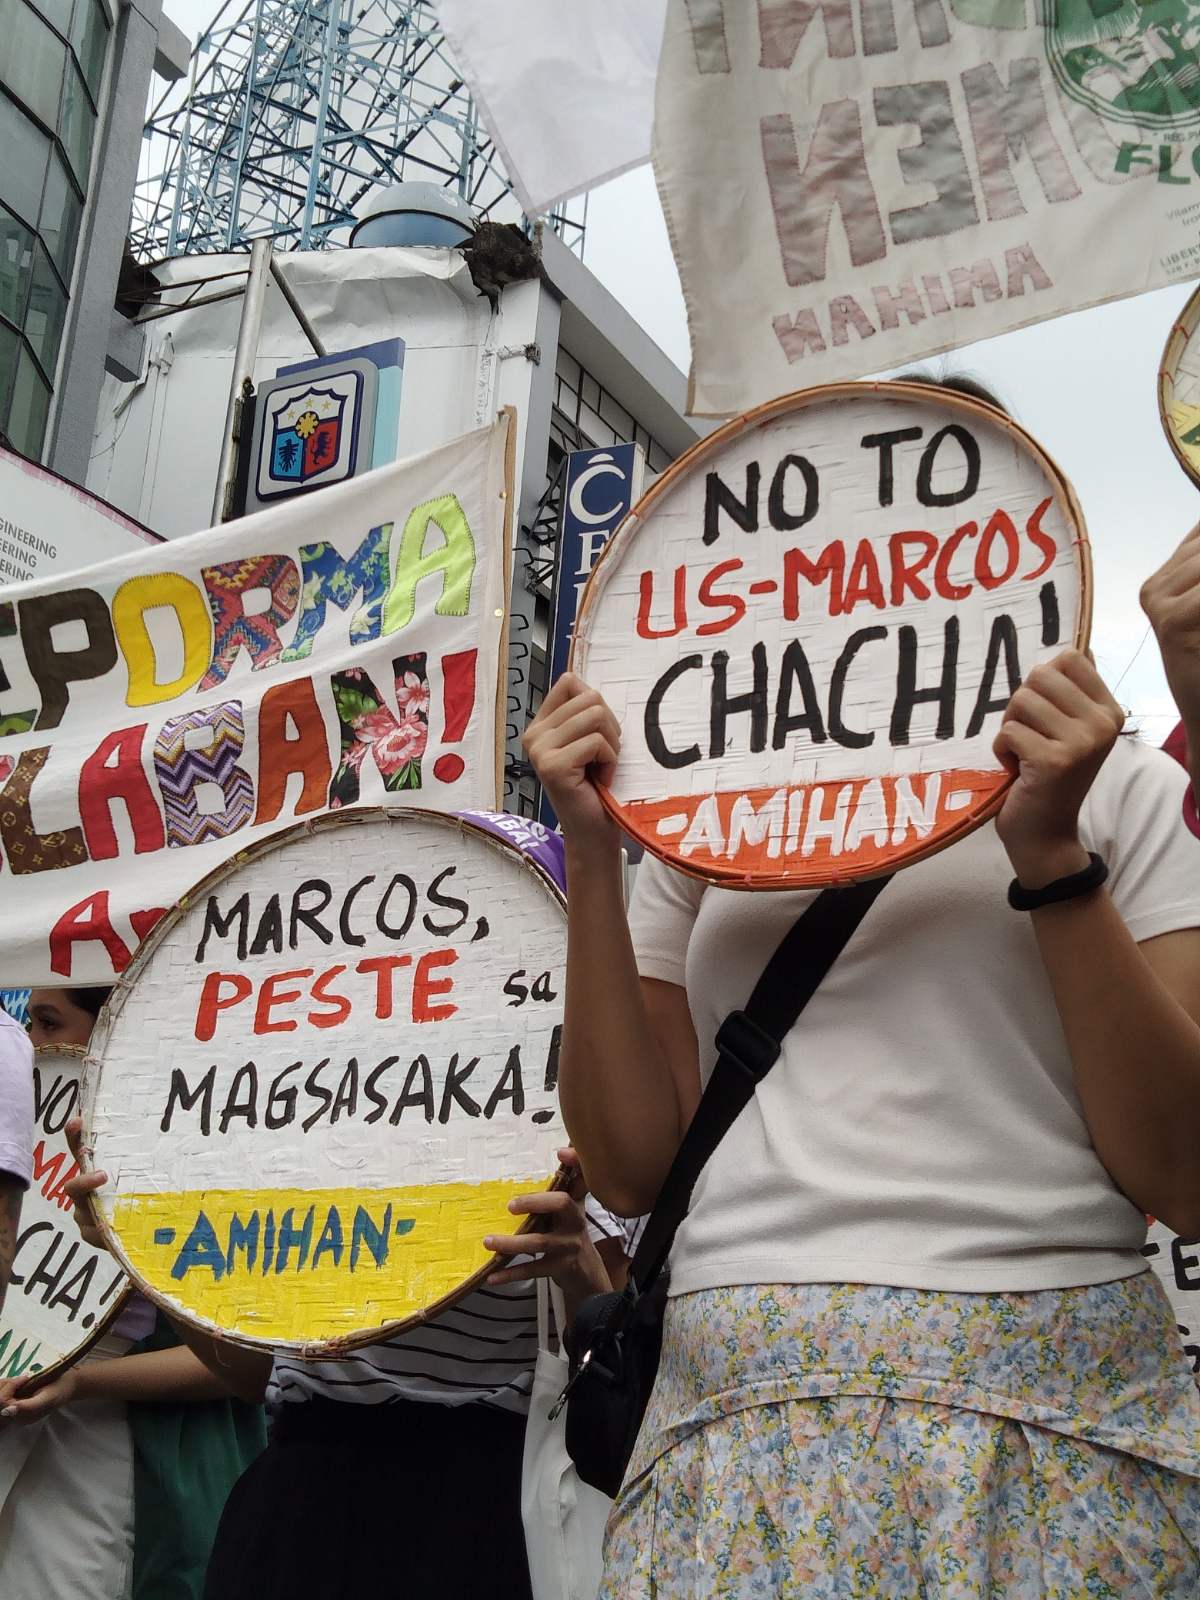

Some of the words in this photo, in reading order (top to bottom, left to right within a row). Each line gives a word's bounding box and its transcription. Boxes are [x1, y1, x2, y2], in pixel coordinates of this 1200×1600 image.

[1114, 140, 1200, 185] FL
[702, 455, 819, 546] NO
[861, 424, 981, 506] TO
[0, 538, 37, 568] ERING
[636, 495, 1056, 640] US-MARCOS
[0, 648, 478, 876] LABAN!
[195, 866, 489, 963] MARCOS,
[194, 949, 459, 1042] PESTE
[503, 969, 557, 1008] sa
[160, 1023, 563, 1137] MAGSASAKA!
